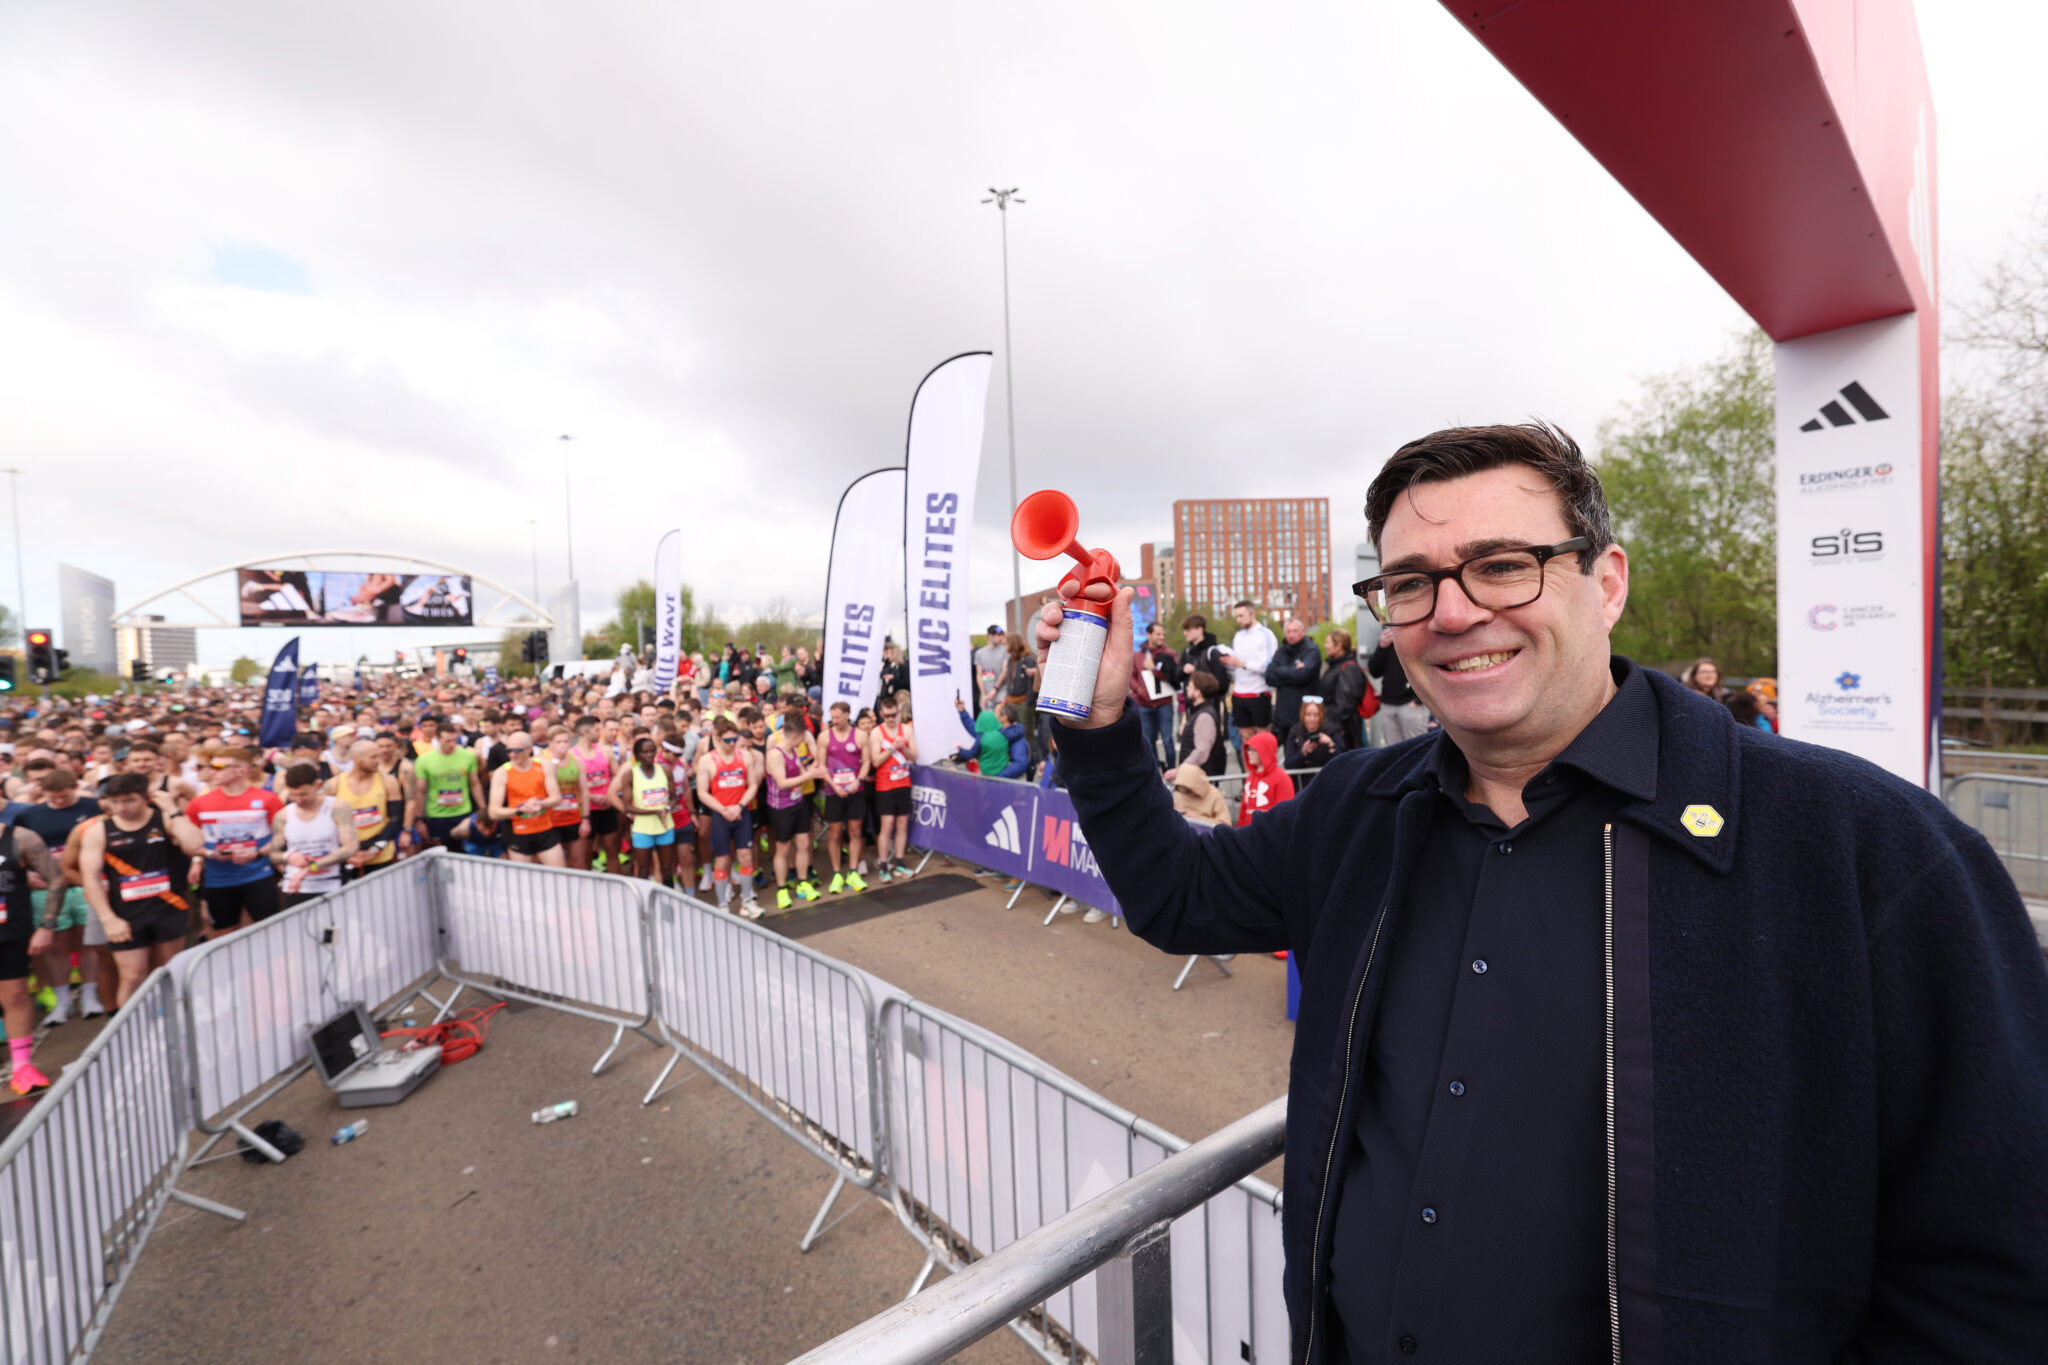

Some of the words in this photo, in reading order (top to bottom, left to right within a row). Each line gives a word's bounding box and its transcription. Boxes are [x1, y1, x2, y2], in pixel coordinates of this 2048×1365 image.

[1799, 466, 1872, 485] ERDINGER
[920, 492, 959, 611] ELITES
[918, 618, 952, 677] WC
